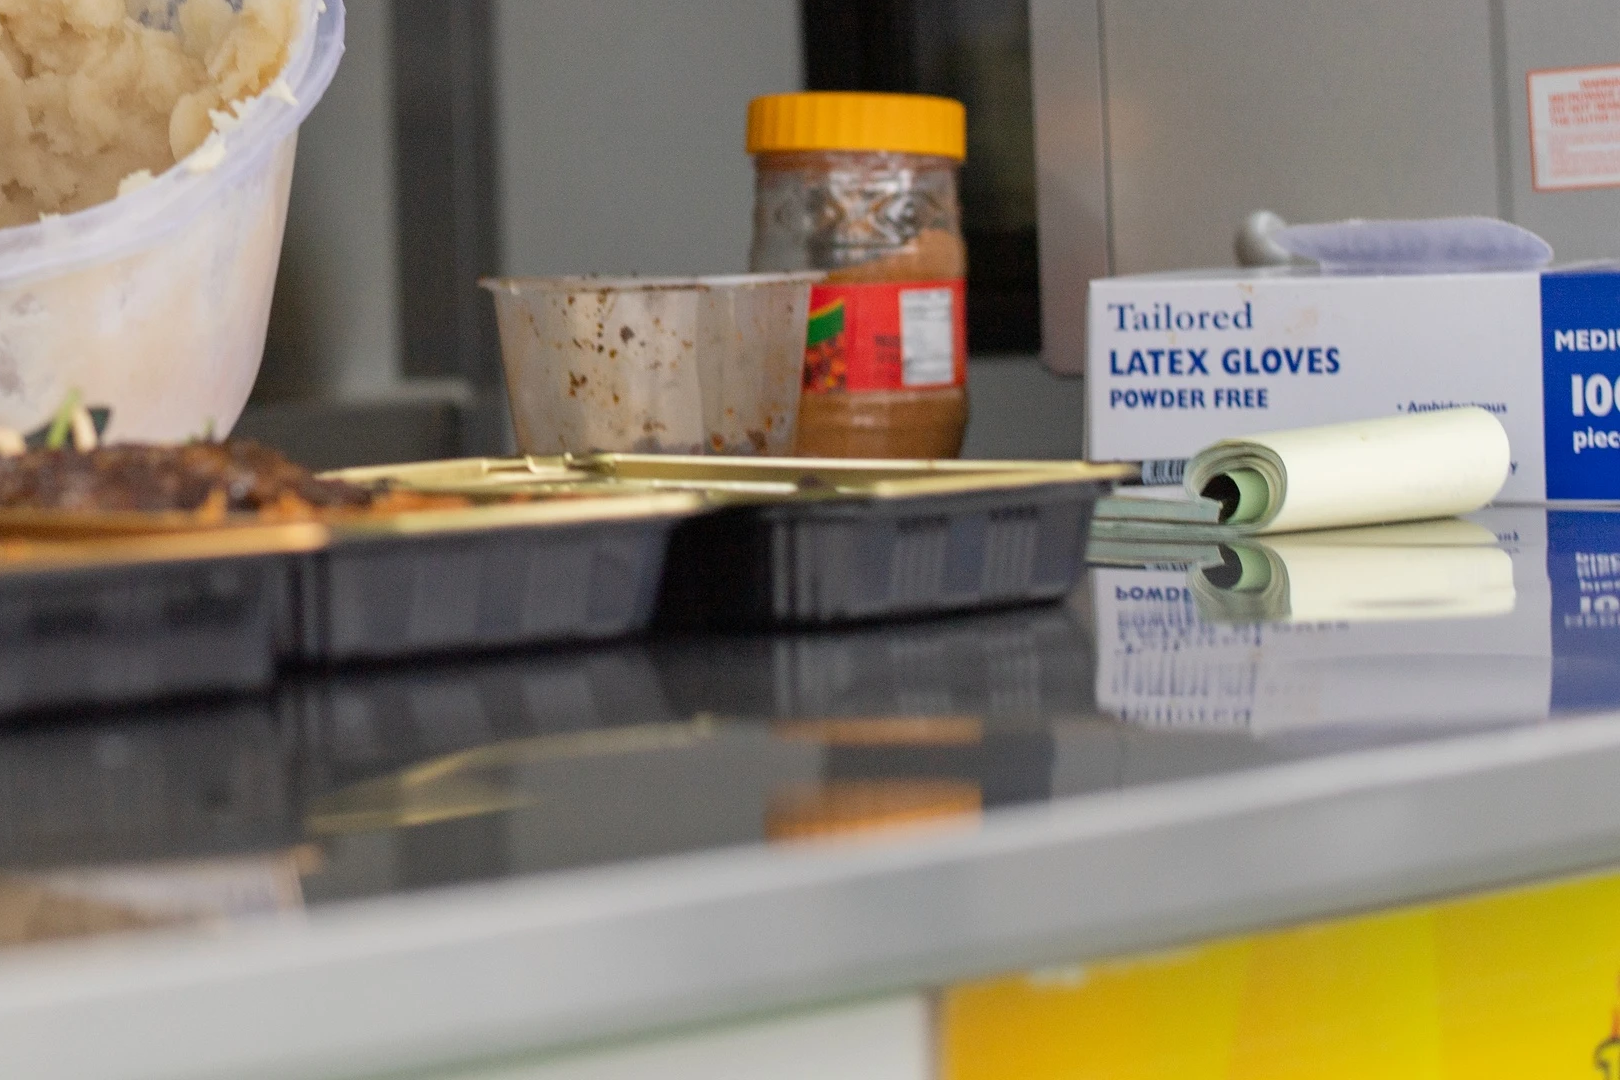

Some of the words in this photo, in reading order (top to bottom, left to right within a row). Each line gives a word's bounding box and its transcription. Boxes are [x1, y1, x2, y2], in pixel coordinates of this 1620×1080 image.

[1108, 301, 1253, 331] Tailored
[1554, 328, 1620, 352] MEDI
[1109, 348, 1209, 376] LATEX
[1221, 347, 1341, 375] GLOVES
[1110, 388, 1206, 409] POWDER
[1213, 387, 1269, 409] FREE
[1571, 373, 1620, 417] 10
[1573, 425, 1620, 455] piec
